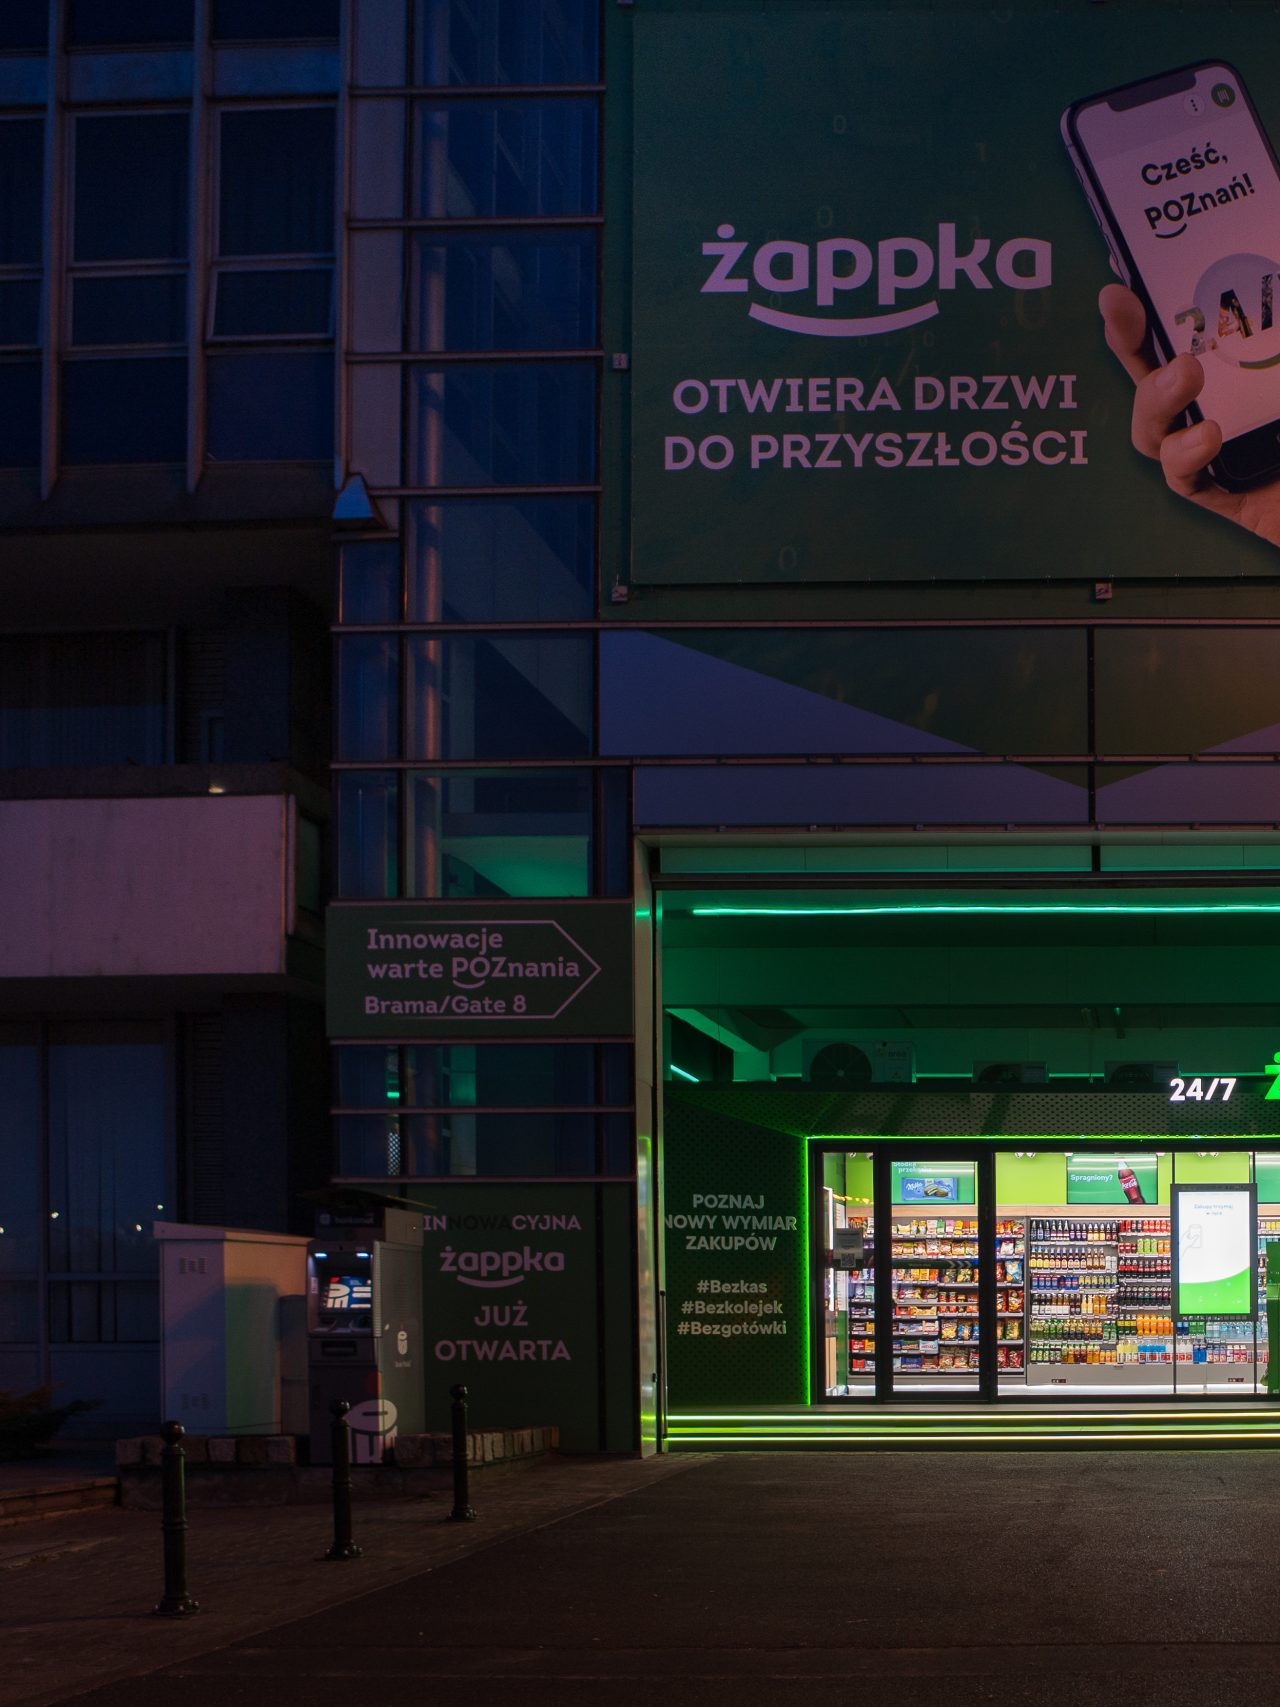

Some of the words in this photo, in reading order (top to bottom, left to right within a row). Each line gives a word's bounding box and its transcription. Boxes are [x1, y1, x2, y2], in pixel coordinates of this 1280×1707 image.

[1141, 141, 1228, 186] Cześć,
[1144, 173, 1256, 231] POZnań!
[700, 222, 1052, 306] żappka
[672, 376, 902, 414] OTWIERA
[913, 374, 1079, 411] DRZWI
[663, 434, 735, 471] DO
[750, 420, 1089, 469] PRZYSZŁOŚCI
[366, 927, 504, 955] Innowacje
[367, 959, 443, 979] warte
[451, 956, 581, 979] POZnania
[364, 995, 507, 1014] Brama/Gate
[513, 994, 527, 1013] 8
[1169, 1078, 1237, 1101] 24/7
[1070, 1174, 1113, 1182] Spragniony?
[692, 1193, 765, 1209] POZNAJ
[423, 1215, 582, 1231] INNOWACYJNA
[664, 1214, 718, 1230] NOWY
[721, 1215, 797, 1231] WYMIAR
[685, 1232, 778, 1251] ZAKUPÓW
[439, 1245, 566, 1277] żappka
[697, 1280, 768, 1294] #Bezkas
[473, 1300, 529, 1327] JUŻ
[680, 1300, 784, 1317] #Bezkolejek
[676, 1320, 788, 1338] #Bezgotówki
[434, 1339, 572, 1361] OTWARTA
